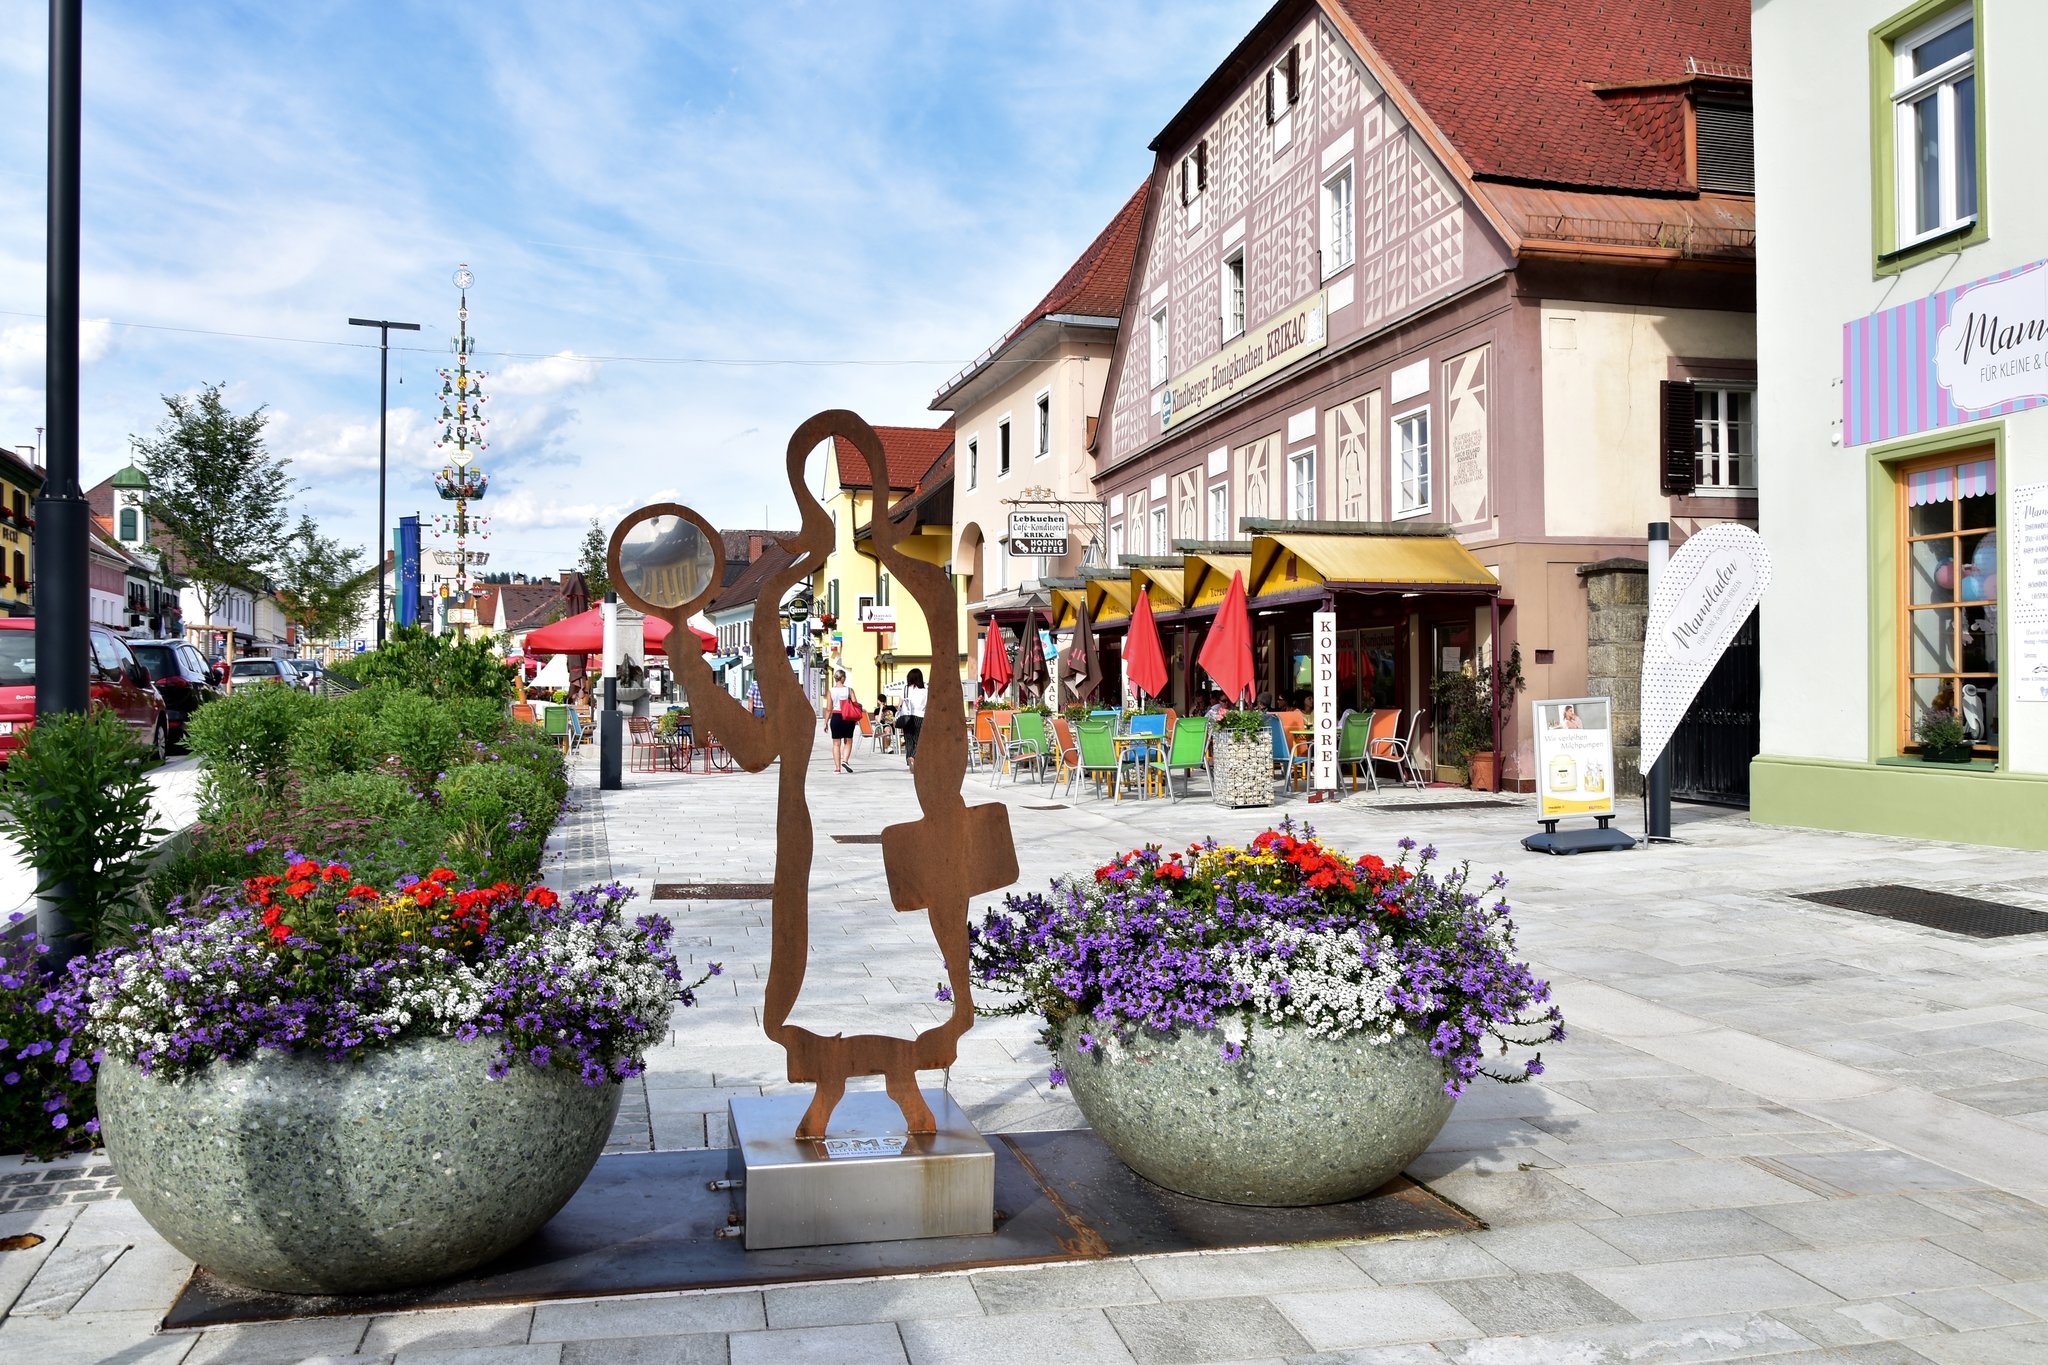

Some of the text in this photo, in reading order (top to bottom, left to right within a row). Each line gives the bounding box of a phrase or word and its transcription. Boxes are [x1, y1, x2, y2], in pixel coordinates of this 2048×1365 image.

[1172, 376, 1210, 414] Kindberger
[1211, 344, 1263, 392] Honigkuchen
[1266, 312, 1306, 362] KRIKAC
[1955, 312, 2048, 365] Mam
[1980, 364, 1996, 382] FÜR
[2000, 356, 2030, 378] KLEINE
[2034, 354, 2041, 370] &
[1672, 559, 1738, 650] Mamiladen
[1321, 621, 1332, 778] KONDITOREI
[1561, 742, 1604, 750] Milchpumpen
[827, 1138, 902, 1149] DMS
